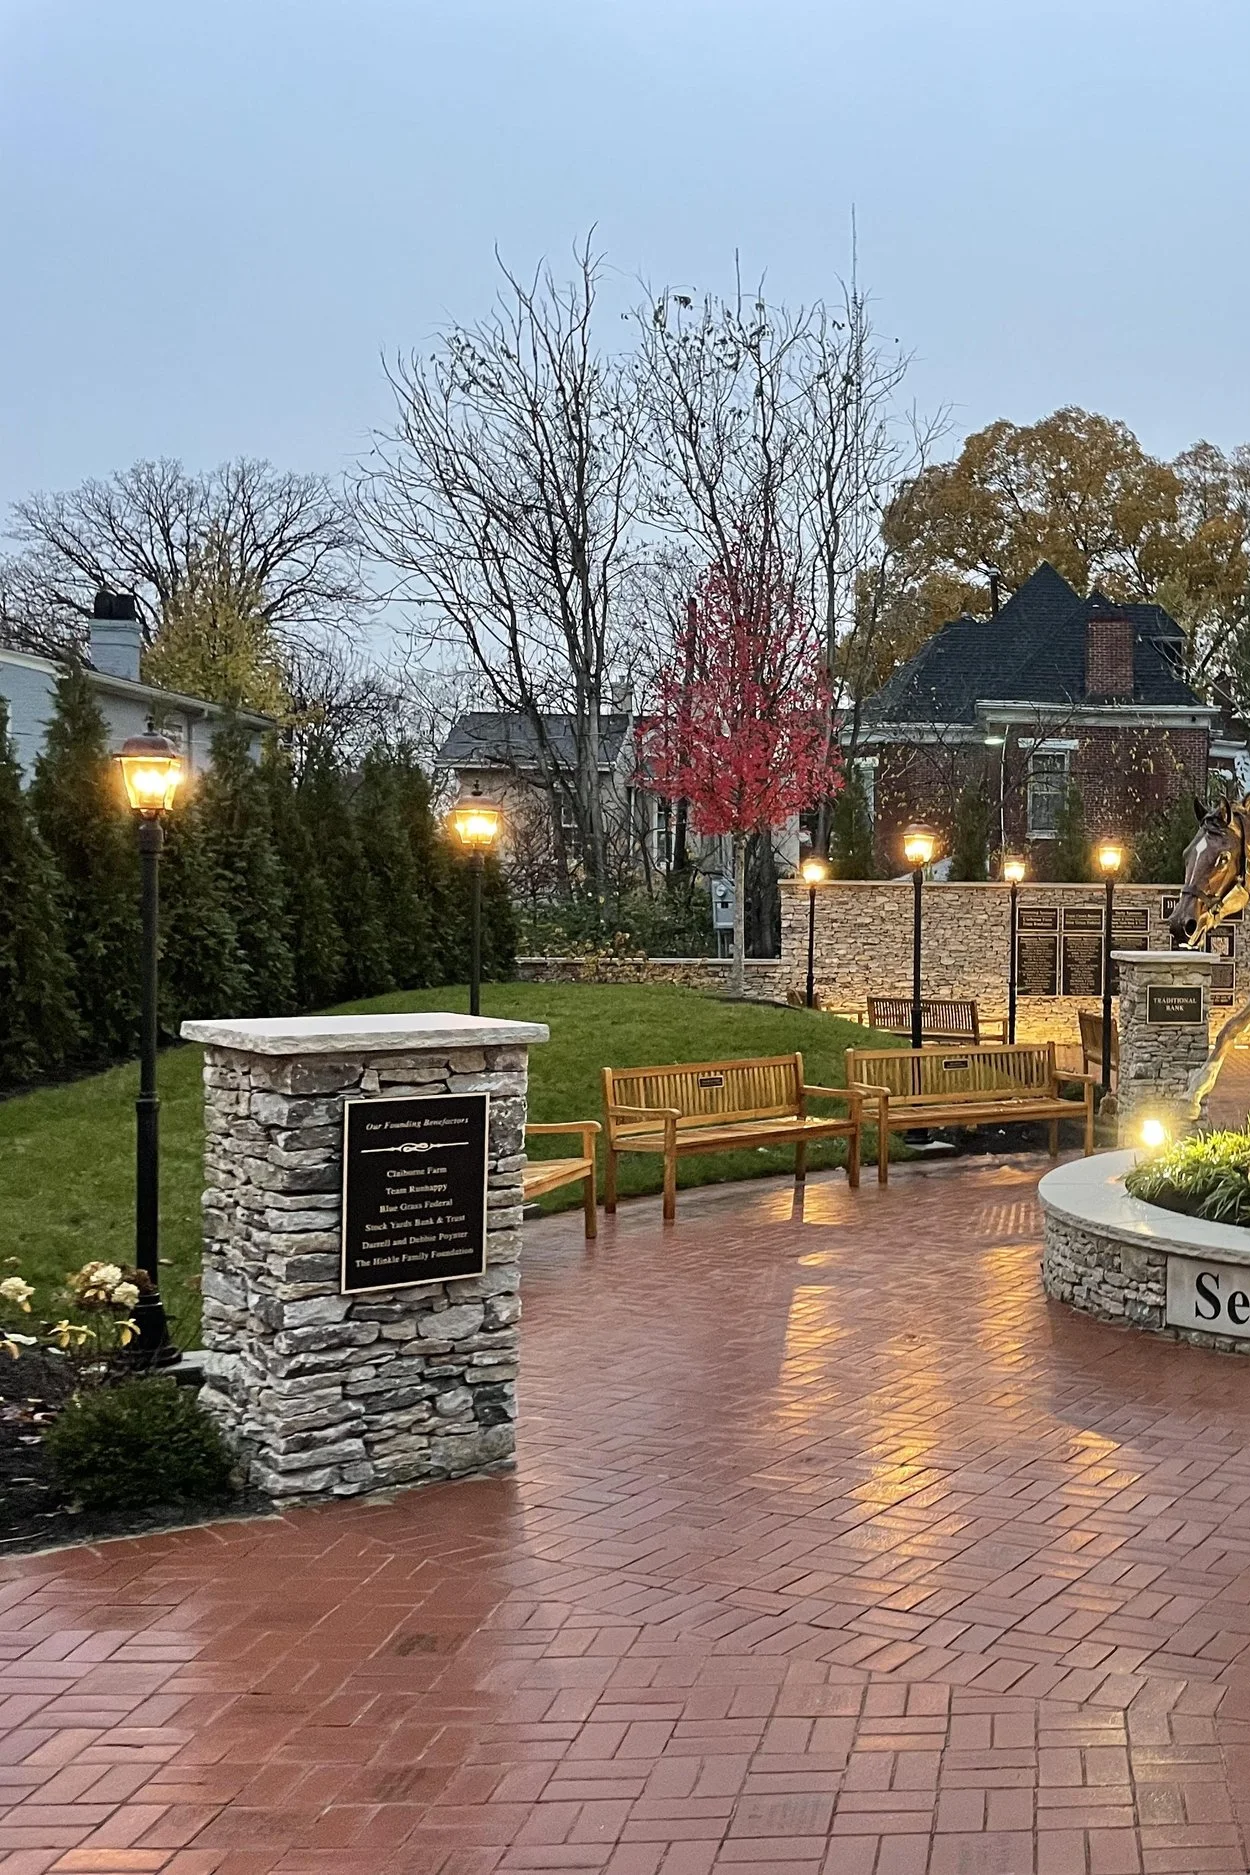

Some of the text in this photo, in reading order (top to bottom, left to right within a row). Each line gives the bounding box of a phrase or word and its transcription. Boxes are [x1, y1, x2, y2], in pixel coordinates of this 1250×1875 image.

[366, 1117, 469, 1131] Our Founding Benefactors
[386, 1166, 447, 1178] Claiborne Farm
[385, 1183, 448, 1195] Team Runhappy
[379, 1198, 453, 1213] Blue Grass Federal
[365, 1214, 466, 1232] Stock Yards Bank & Trust
[362, 1239, 391, 1250] Darrell
[392, 1237, 407, 1246] and
[409, 1235, 436, 1244] Debbie
[355, 1247, 474, 1268] The Hinkle Family Foundation
